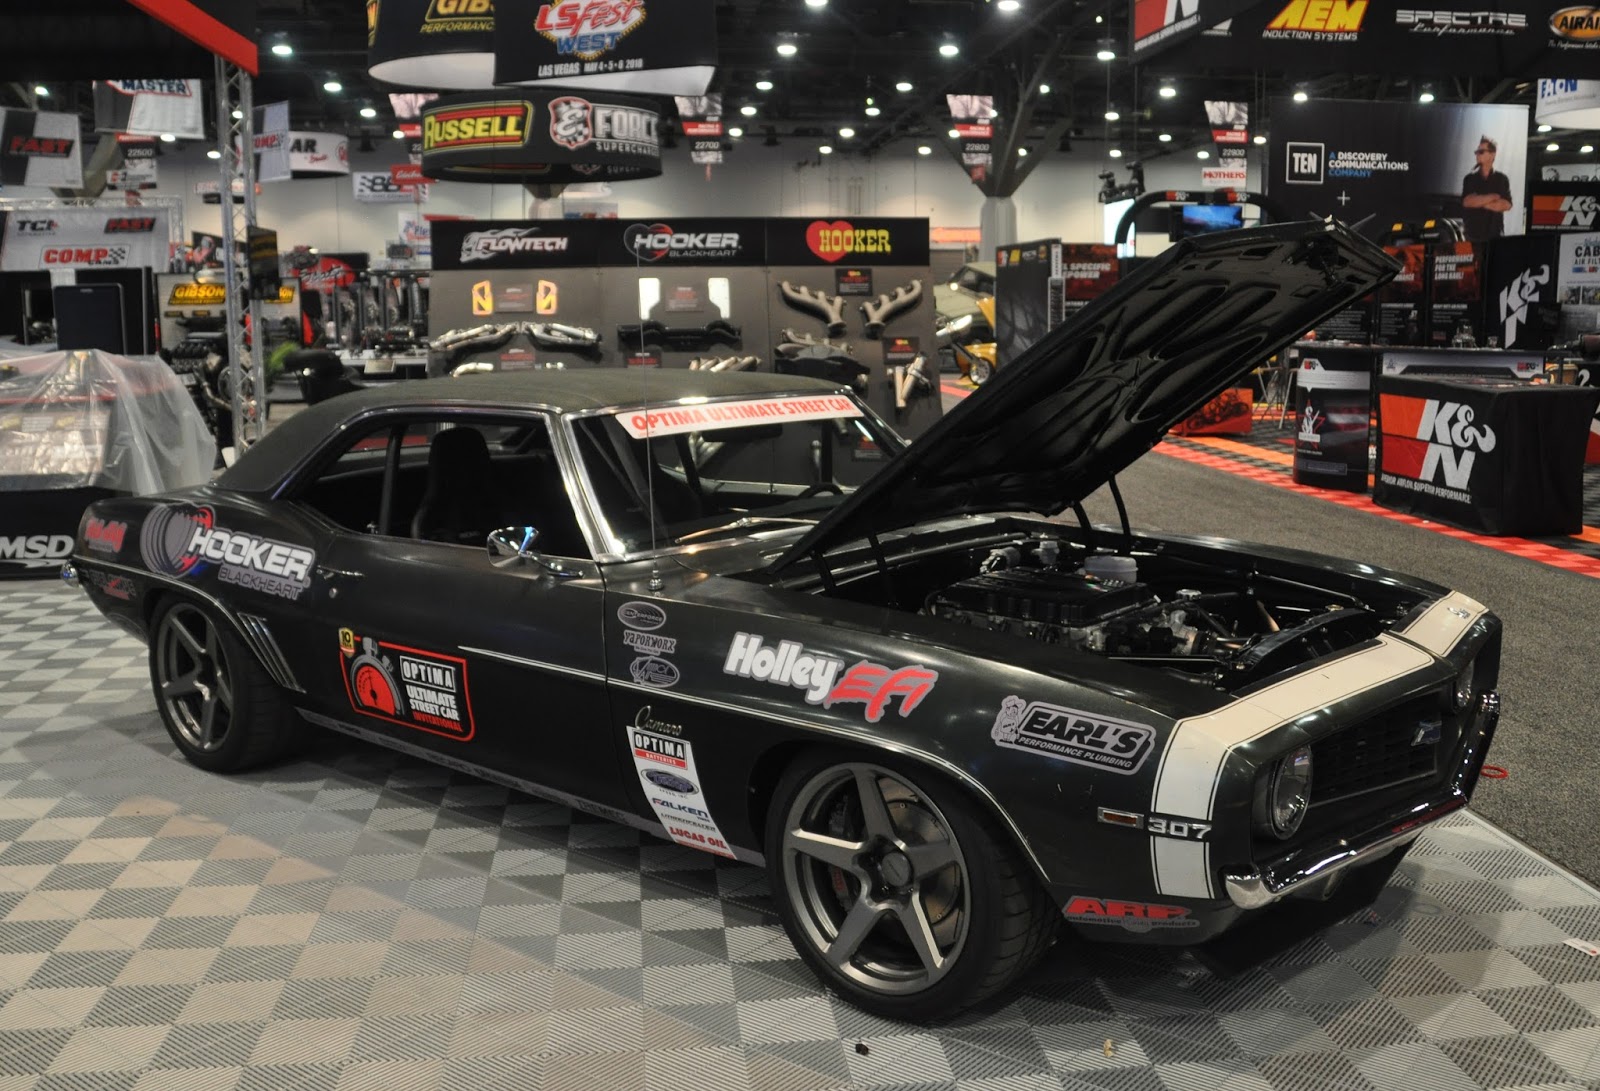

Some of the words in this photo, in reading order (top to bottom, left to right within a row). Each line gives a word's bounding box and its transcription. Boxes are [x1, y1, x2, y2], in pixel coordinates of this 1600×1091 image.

[1266, 0, 1371, 31] AEM
[1396, 10, 1527, 26] SPECTRE
[1559, 16, 1600, 30] AIRAI
[419, 21, 495, 33] PERFORMANC
[1262, 30, 1312, 39] INDUCTION
[1313, 31, 1358, 41] SYSTEMS
[557, 32, 620, 54] WEST
[538, 64, 554, 77] LAS
[554, 62, 580, 76] VEGAS
[122, 80, 187, 94] MASTER
[424, 114, 523, 150] RUSSELL
[695, 141, 720, 149] 22700
[1328, 151, 1336, 160] A
[1337, 152, 1388, 161] DISCOVERY
[1292, 152, 1318, 174] TEN
[1328, 160, 1410, 171] COMMUNICATIONS
[1328, 169, 1373, 178] COMPANY
[1203, 171, 1246, 179] MOTHERS
[477, 236, 569, 254] FLOWTECH
[634, 232, 741, 249] HOOKER
[818, 229, 892, 253] HOOKER
[1575, 245, 1600, 258] CAB
[44, 247, 109, 264] COMP
[669, 249, 737, 257] BLACKHEART
[174, 284, 226, 298] GIBSON
[631, 409, 708, 430] OPTIMA
[711, 401, 787, 422] ULTIMATE
[787, 398, 829, 414] STREET
[829, 397, 856, 411] CAR
[0, 535, 75, 559] MSD
[188, 526, 312, 582] HOOKER
[220, 567, 303, 599] BLACKHEART
[340, 630, 351, 643] 10
[402, 660, 453, 689] OPTIMA
[725, 634, 839, 701] Holley
[406, 684, 457, 709] ULTIMATE
[828, 662, 934, 720] EFI
[409, 698, 440, 717] STREET
[440, 705, 460, 721] CAR
[634, 705, 682, 736] Camaro
[413, 711, 463, 732] INVITATIONAL
[1021, 709, 1144, 755] EARL'S
[634, 733, 684, 759] OPTIMA
[1018, 736, 1083, 759] PERFORMANCE
[1083, 750, 1133, 769] PLUMBING
[645, 752, 677, 766] BATTERIES
[652, 796, 709, 819] FALKEN
[669, 826, 705, 844] LUCAS
[707, 836, 727, 850] OIL
[1147, 817, 1212, 839] 307
[1064, 897, 1187, 919] ARP
